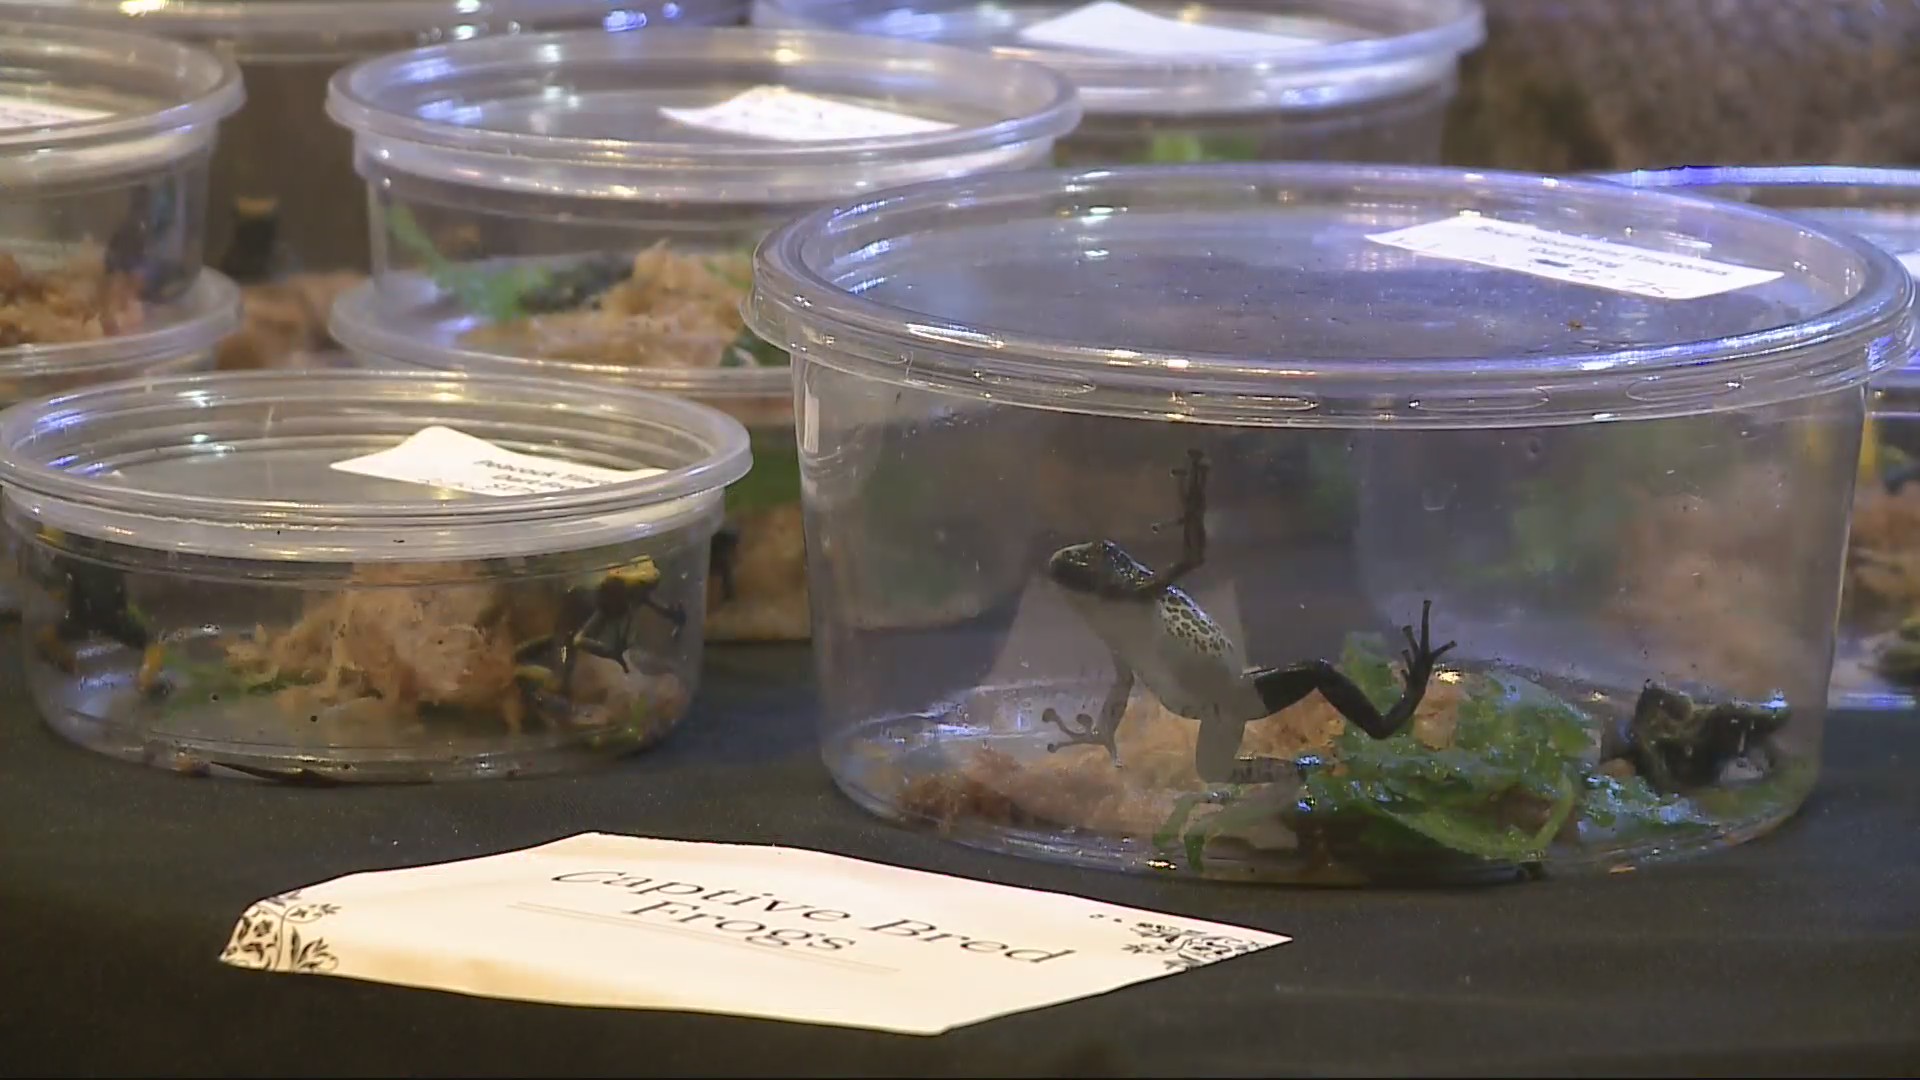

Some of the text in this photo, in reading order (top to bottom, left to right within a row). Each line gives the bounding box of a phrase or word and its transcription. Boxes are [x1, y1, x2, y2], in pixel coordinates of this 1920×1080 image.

[550, 870, 1077, 964] Captive Bred
[621, 900, 857, 951] Frogs
